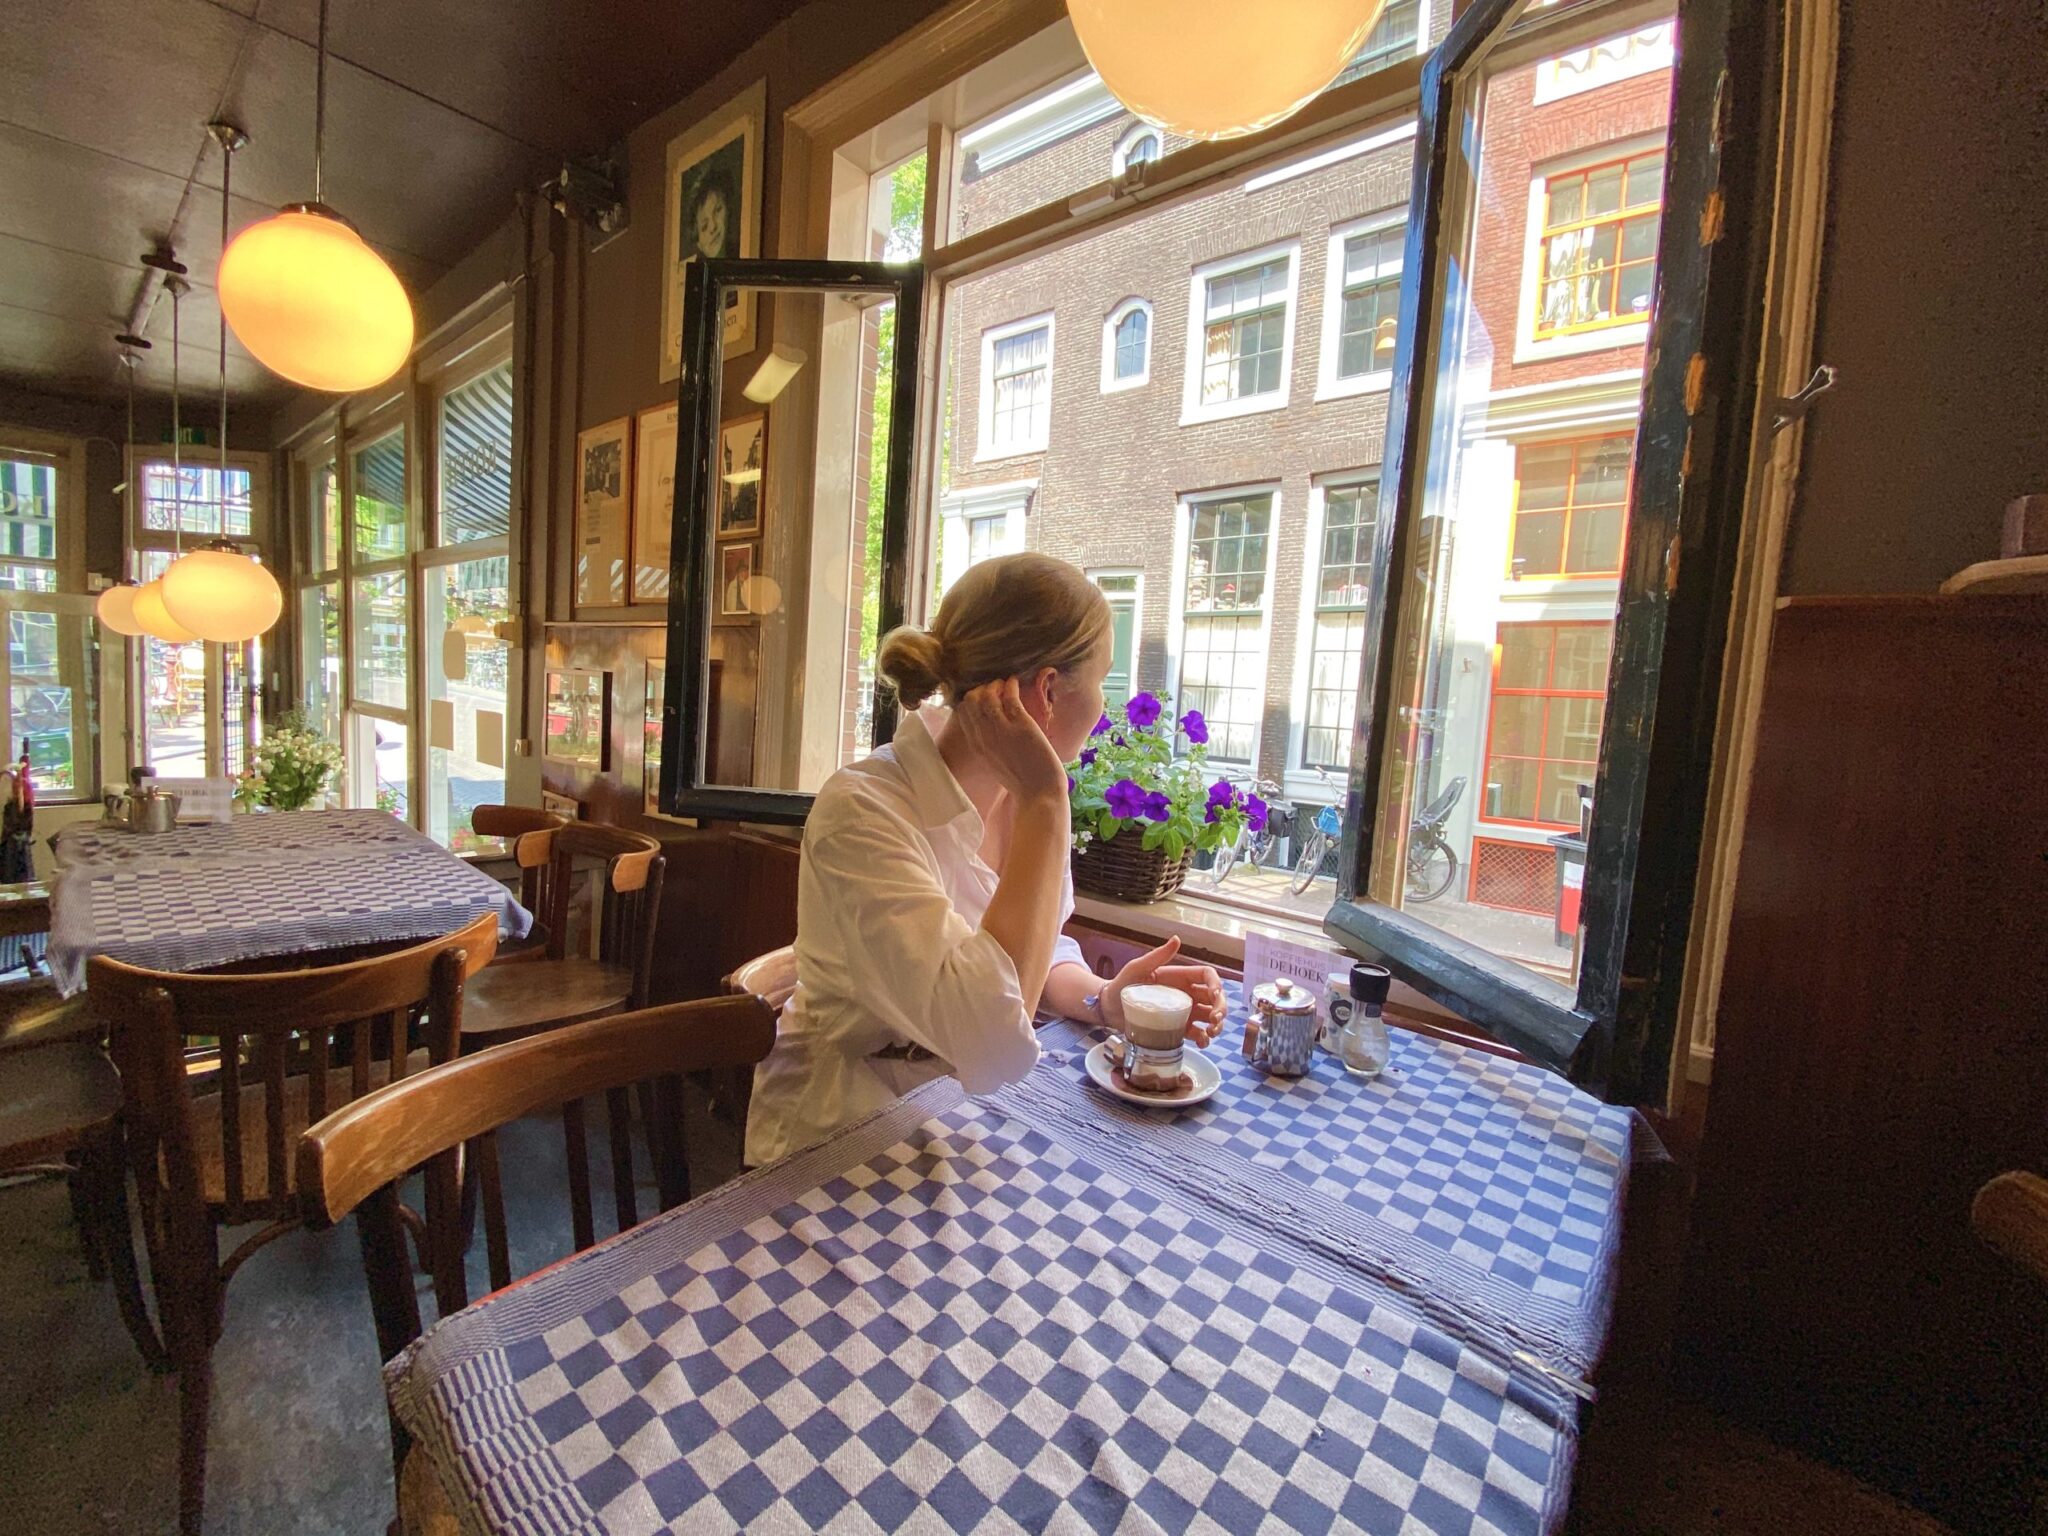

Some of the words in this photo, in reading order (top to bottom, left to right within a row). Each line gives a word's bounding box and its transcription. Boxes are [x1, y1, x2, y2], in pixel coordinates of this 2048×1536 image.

[1270, 948, 1326, 971] KOFFIEHUIS
[1270, 958, 1287, 973] DE
[1289, 963, 1325, 984] HOEK
